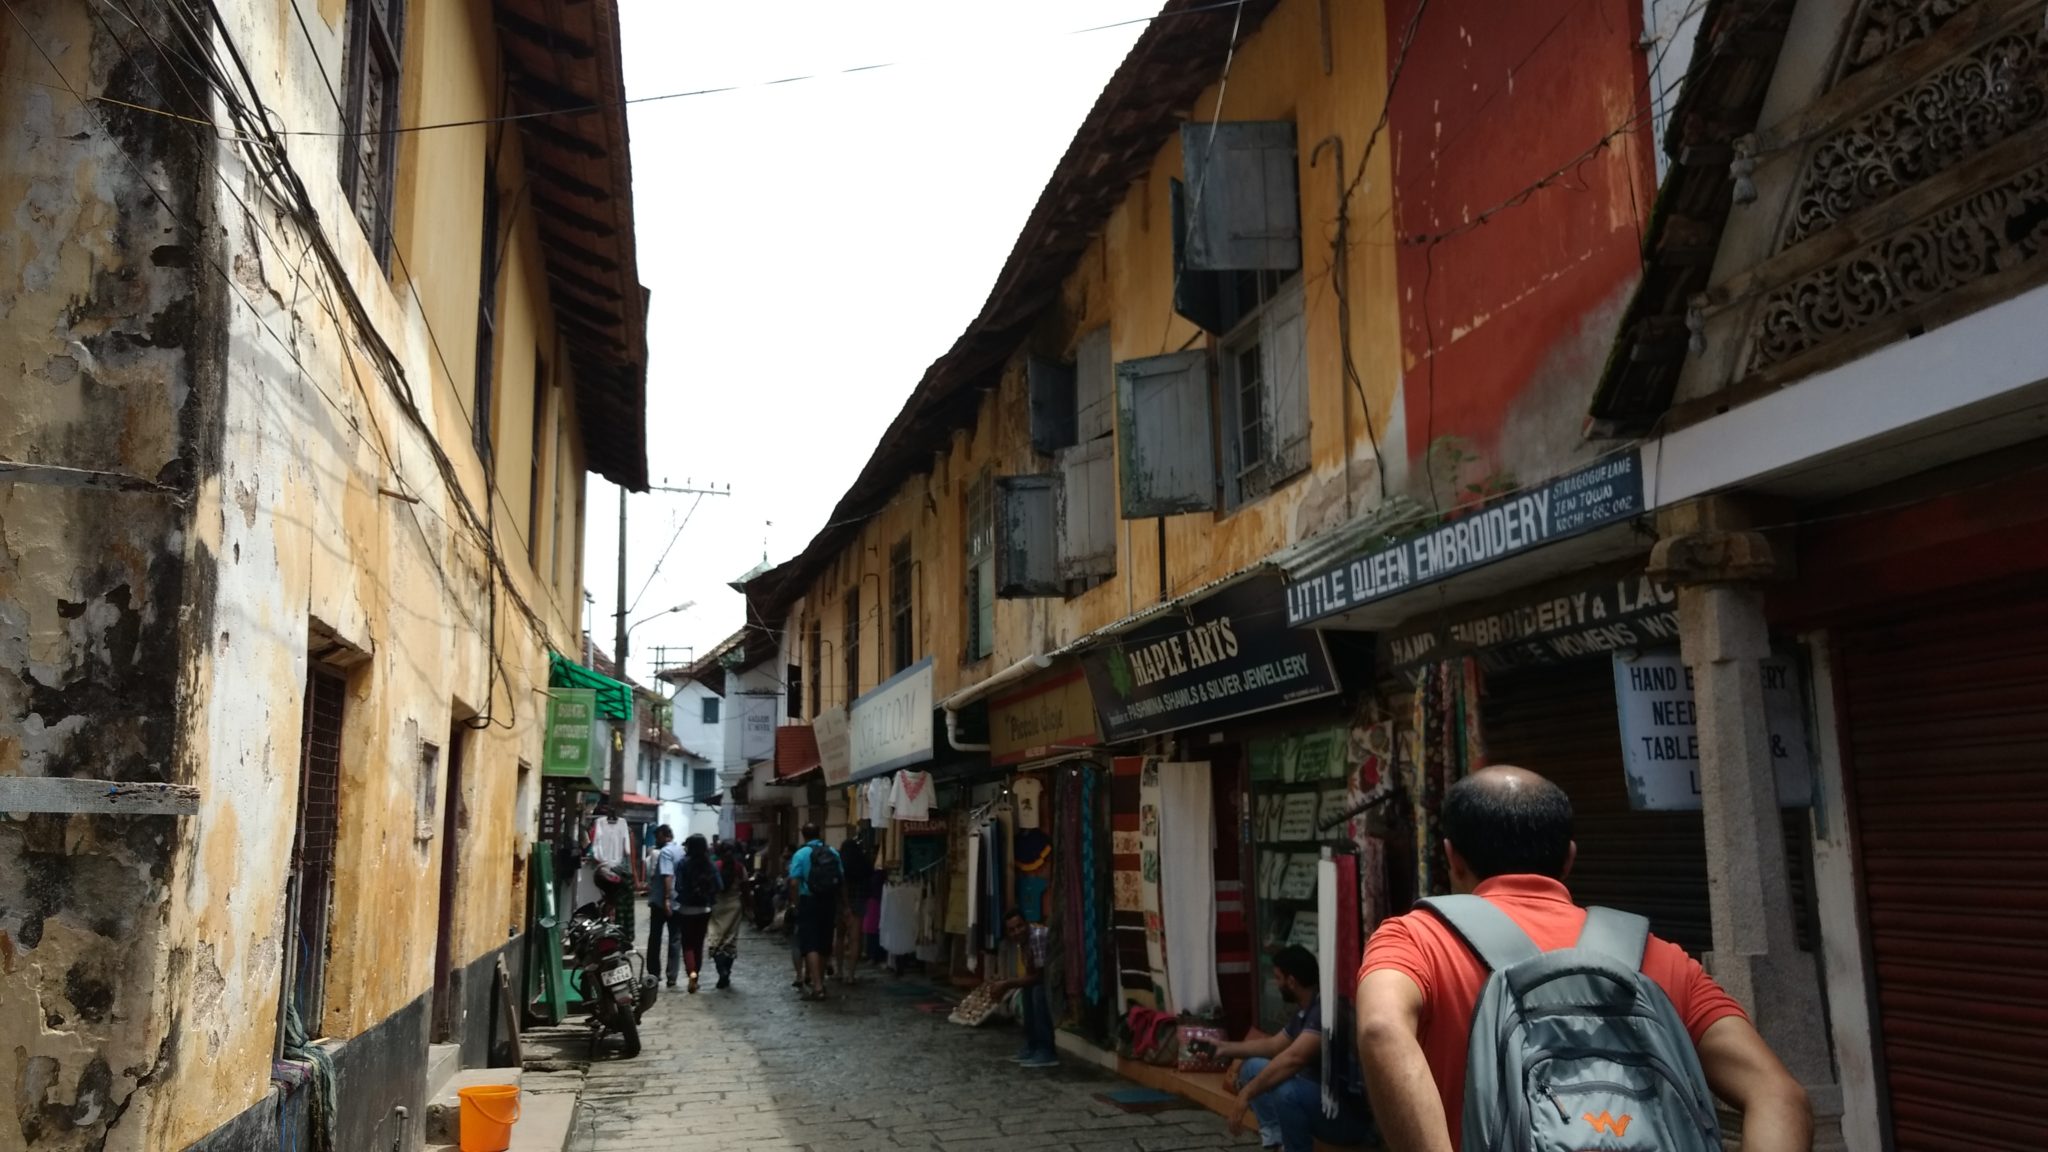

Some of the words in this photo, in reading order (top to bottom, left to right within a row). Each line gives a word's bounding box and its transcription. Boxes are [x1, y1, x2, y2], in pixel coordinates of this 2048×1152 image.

[1607, 457, 1632, 480] LANE
[1579, 484, 1613, 508] TOWN
[1287, 568, 1346, 622] LITTLE
[1350, 543, 1410, 602] QUEEN
[1413, 488, 1550, 581] EMBROIDERY
[1592, 595, 1607, 619] &
[1617, 575, 1676, 614] LAC
[1548, 622, 1638, 658] WOMENS
[1637, 610, 1680, 640] WO
[1129, 635, 1188, 687] MAPLE
[1186, 616, 1239, 669] ARTS
[1163, 686, 1200, 711] SHAWLS
[1198, 683, 1209, 702] &
[1206, 674, 1243, 700] SILVER
[1242, 652, 1310, 691] JEWELLERY
[1630, 666, 1677, 691] HAND
[1652, 701, 1697, 725] NEED
[1772, 734, 1787, 758] &
[543, 782, 555, 834] LEATHER
[903, 819, 947, 833] SHALOM
